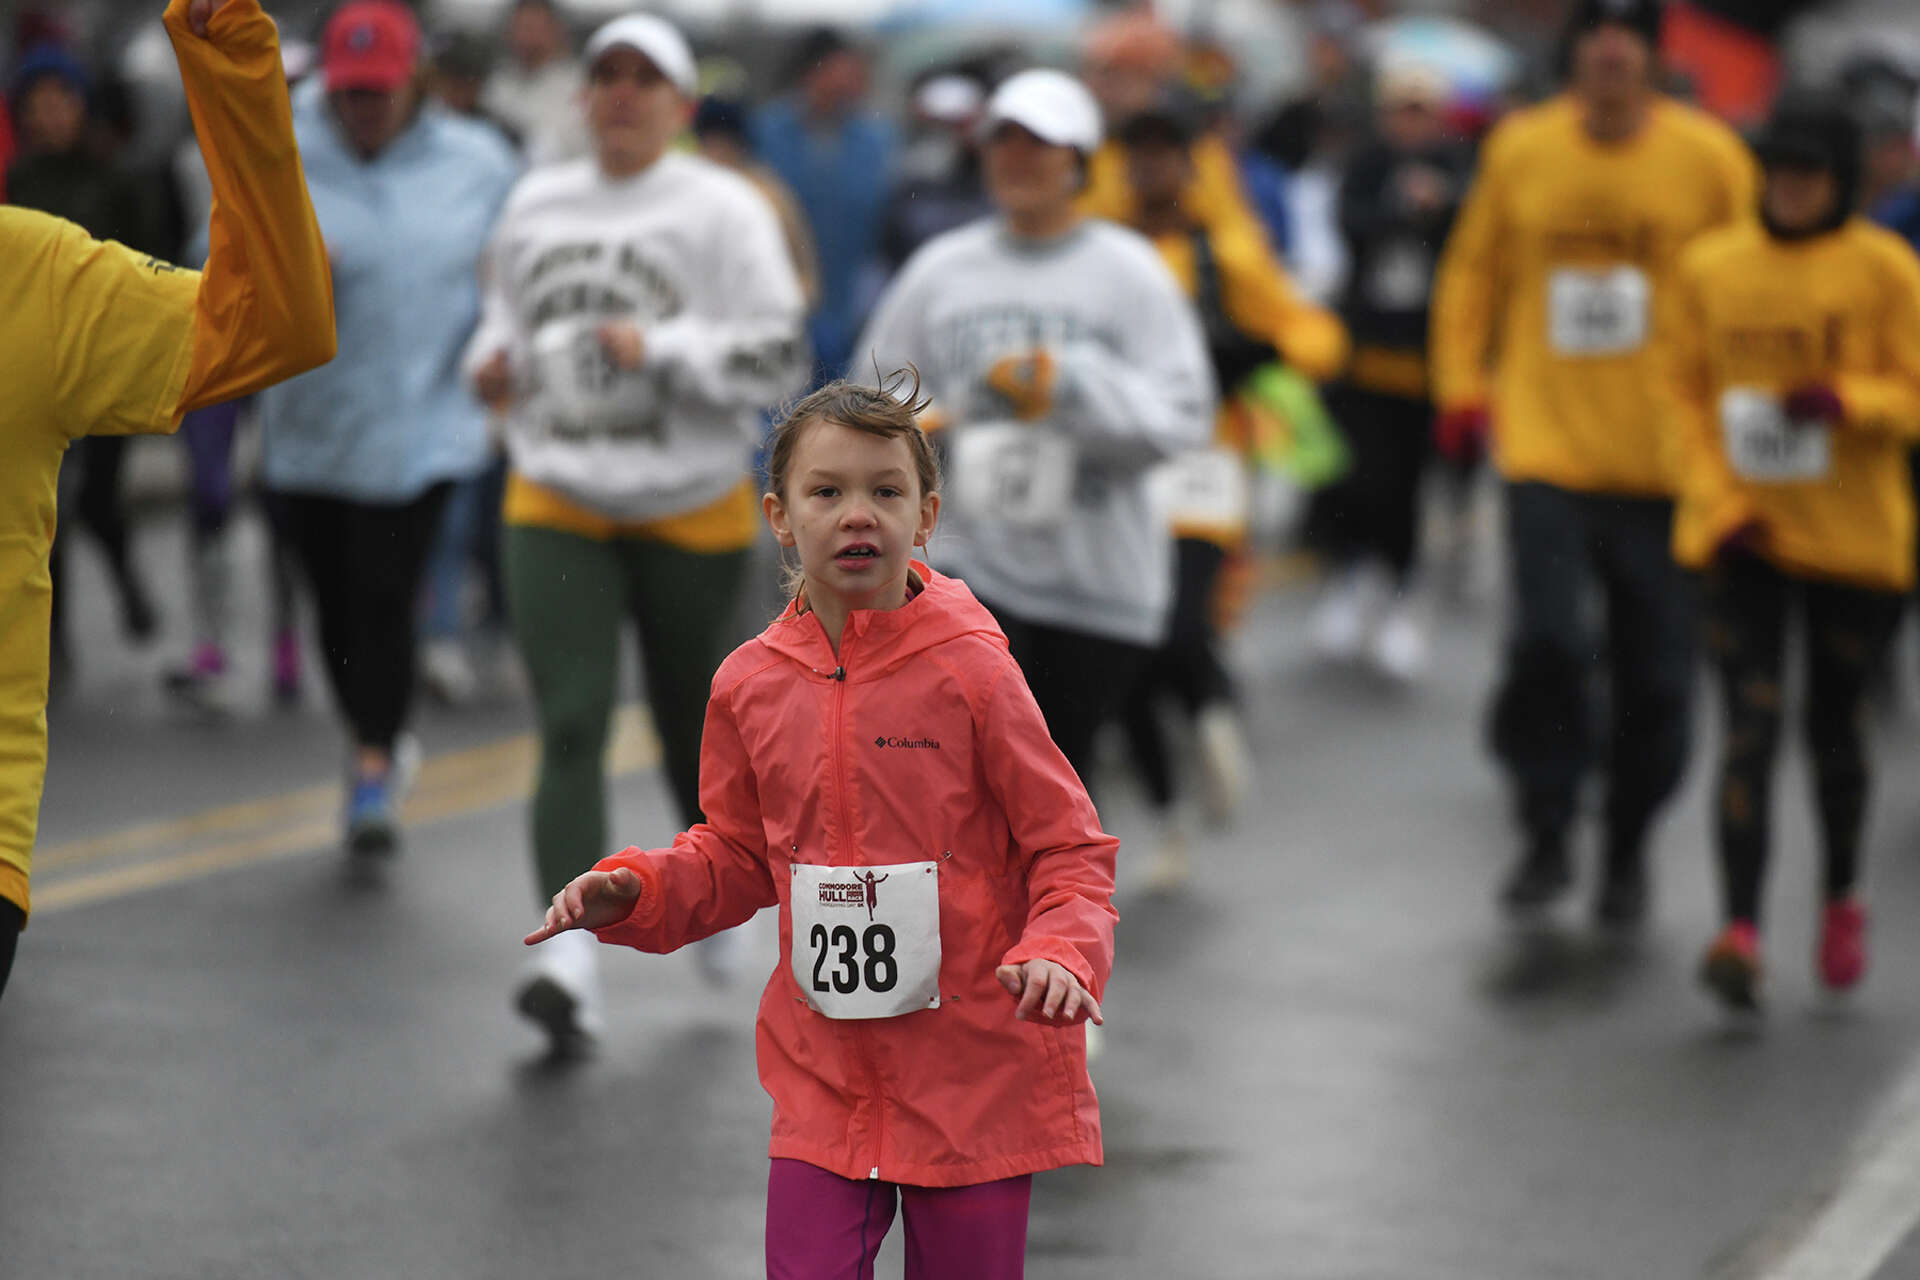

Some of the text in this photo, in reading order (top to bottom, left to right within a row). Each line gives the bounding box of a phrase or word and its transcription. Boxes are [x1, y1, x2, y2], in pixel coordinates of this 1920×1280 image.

[887, 737, 940, 749] Columbia
[819, 882, 863, 890] COMMODORE
[819, 890, 846, 902] HULL
[810, 923, 898, 994] 238
